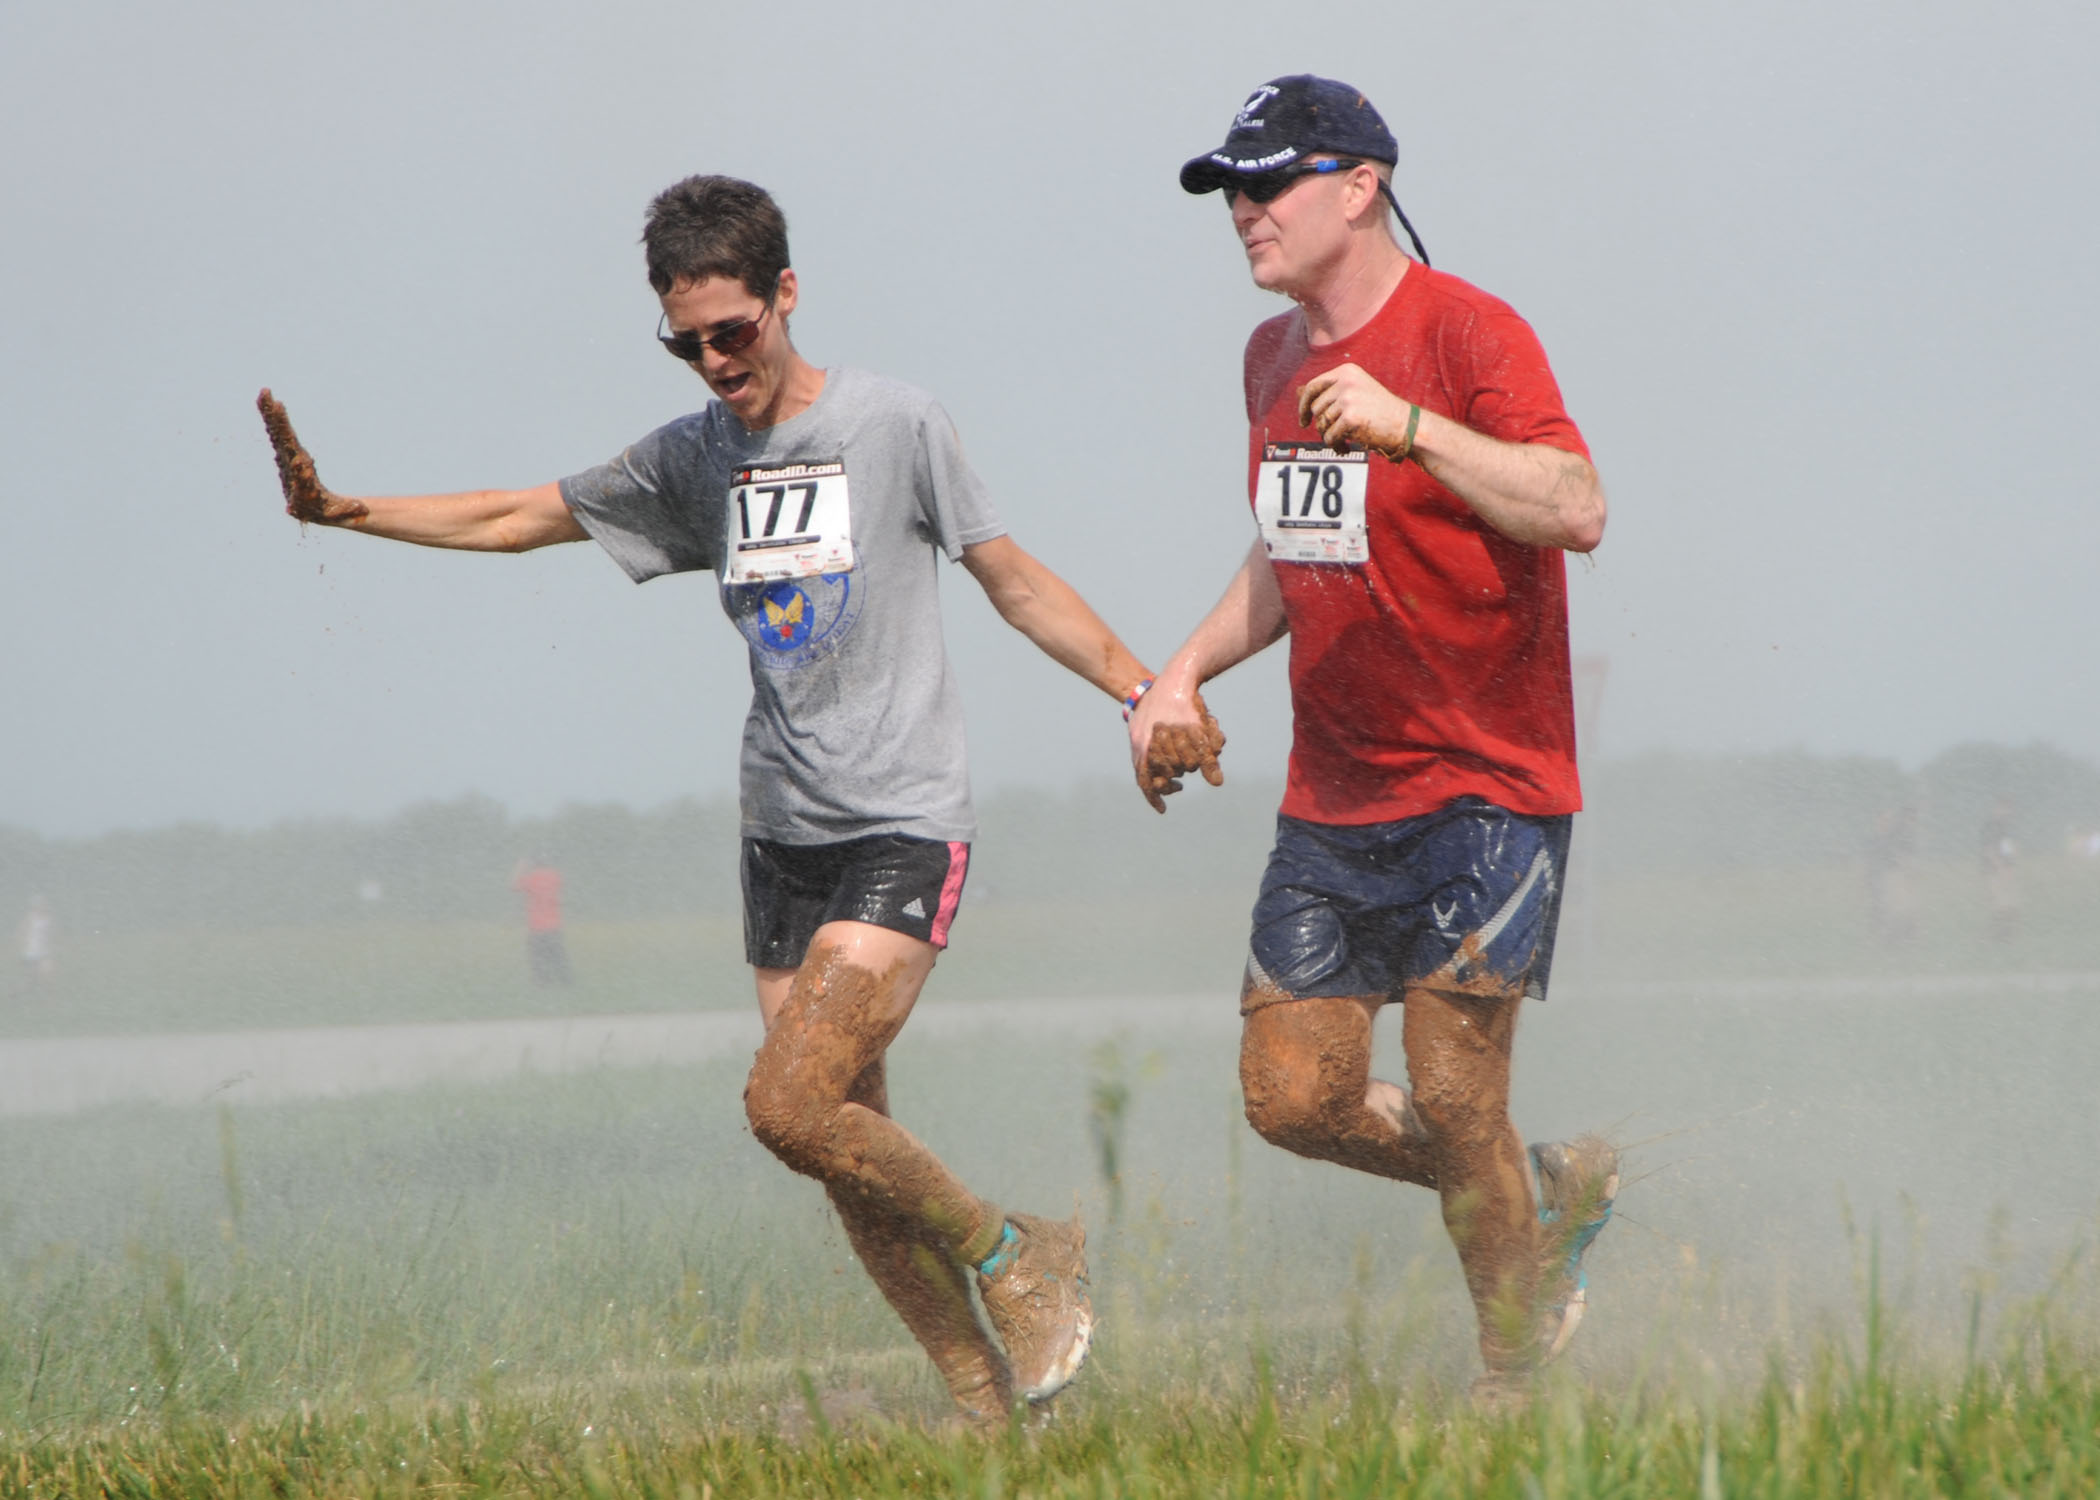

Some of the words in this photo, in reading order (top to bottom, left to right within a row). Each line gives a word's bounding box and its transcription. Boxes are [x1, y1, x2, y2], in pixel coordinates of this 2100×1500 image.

[1236, 159, 1259, 168] AIR
[1258, 146, 1297, 167] FORCE
[751, 463, 842, 482] RoadID.com
[737, 481, 818, 539] 177
[1277, 465, 1343, 518] 178
